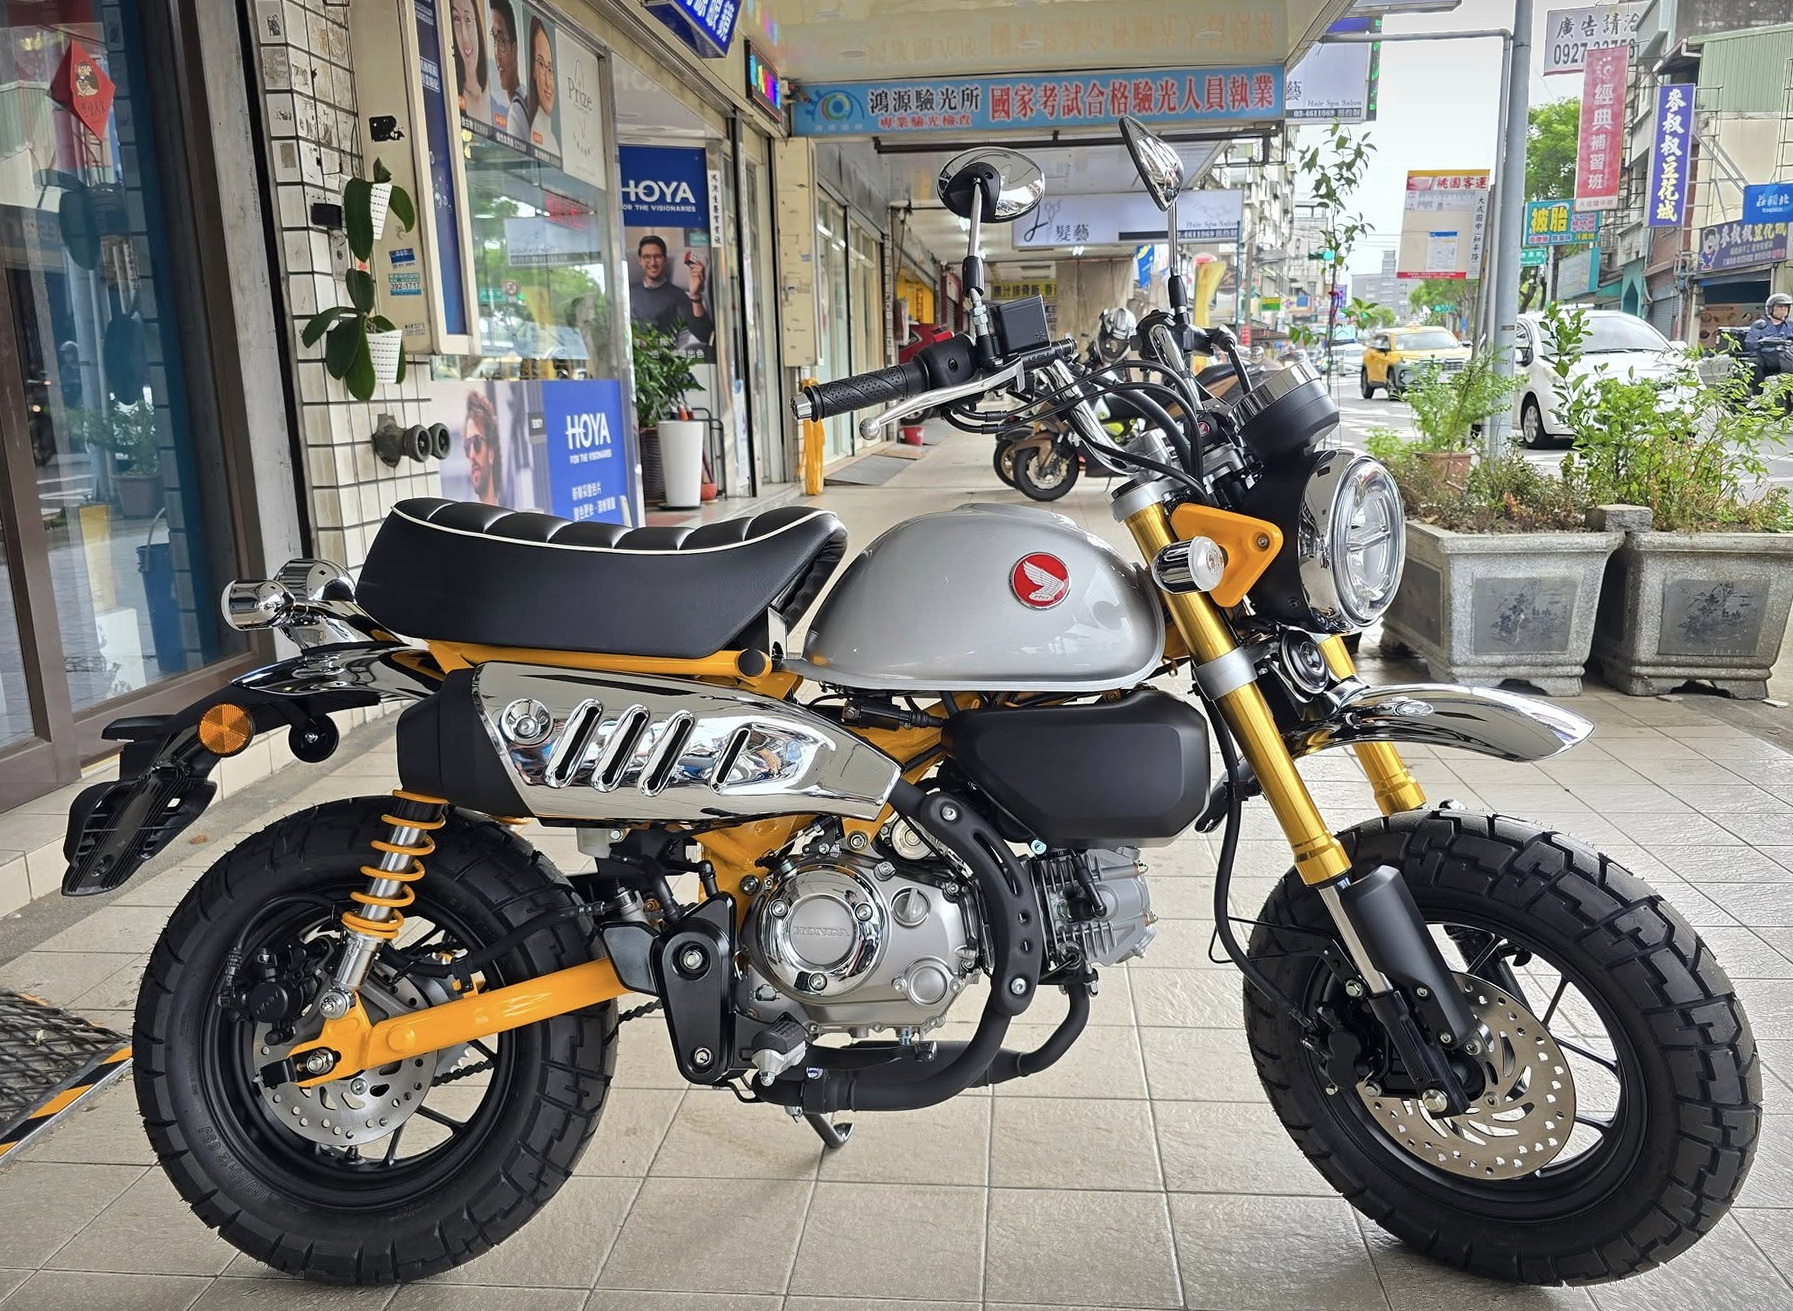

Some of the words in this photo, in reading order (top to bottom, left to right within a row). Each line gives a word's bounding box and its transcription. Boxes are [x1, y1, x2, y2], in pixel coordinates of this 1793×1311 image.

[869, 86, 981, 114] 鴻源驗光所
[990, 75, 1274, 121] 國家考試合格驗光人員執業
[1587, 83, 1615, 190] 經典補習班
[1656, 88, 1687, 222] 麥叔叔豆花城
[1437, 176, 1488, 189] 桃園客運
[1055, 224, 1090, 242] 髮藝
[565, 413, 612, 450] HOYA
[793, 926, 851, 937] HONDA
